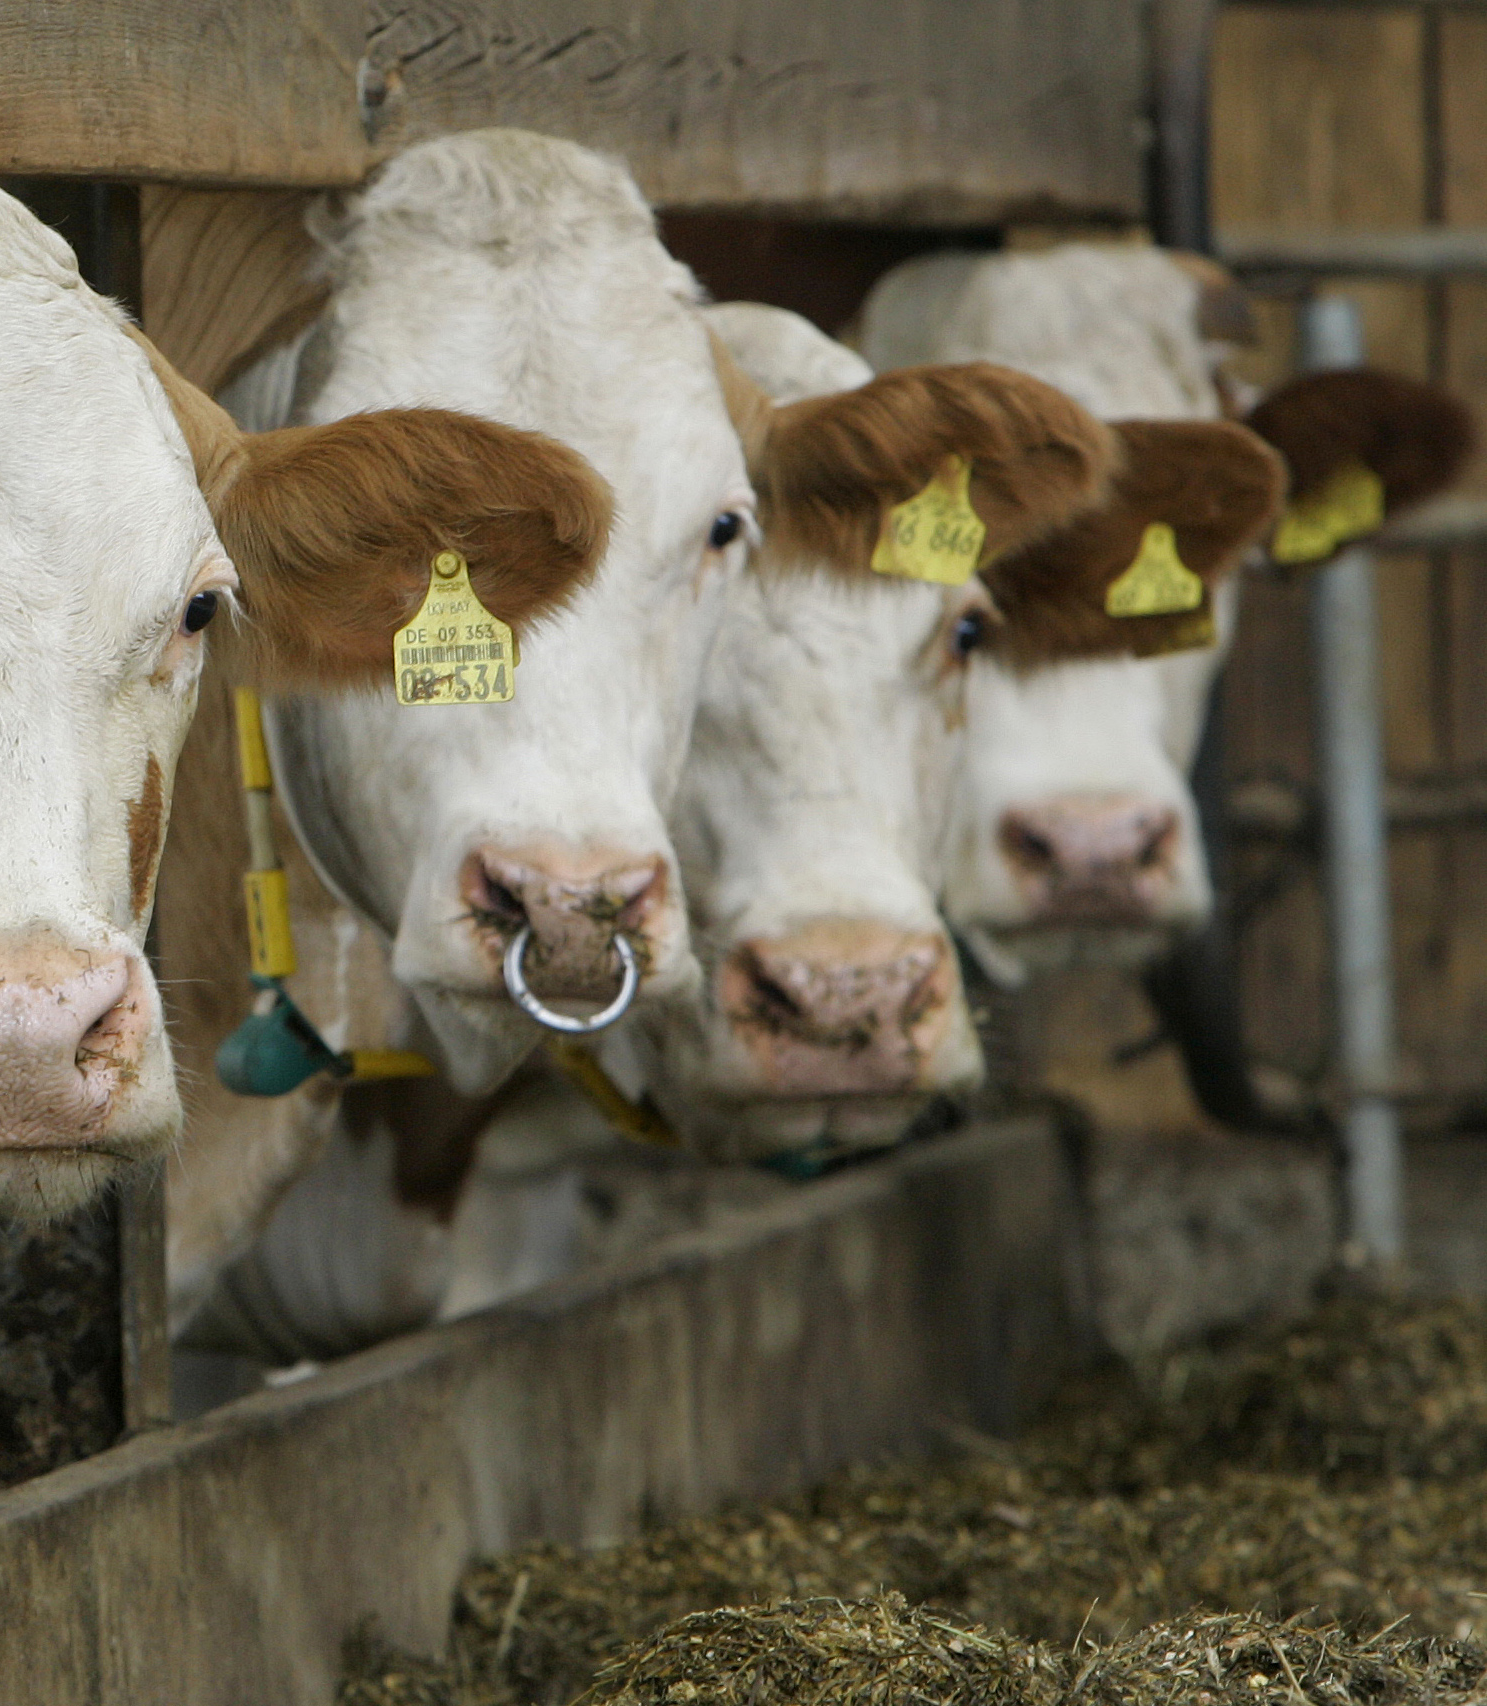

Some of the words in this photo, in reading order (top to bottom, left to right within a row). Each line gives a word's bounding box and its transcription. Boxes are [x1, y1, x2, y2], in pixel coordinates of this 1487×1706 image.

[929, 520, 979, 555] 846
[406, 628, 428, 644] DE
[438, 627, 457, 642] 09
[466, 624, 495, 640] 353
[454, 663, 508, 701] 534
